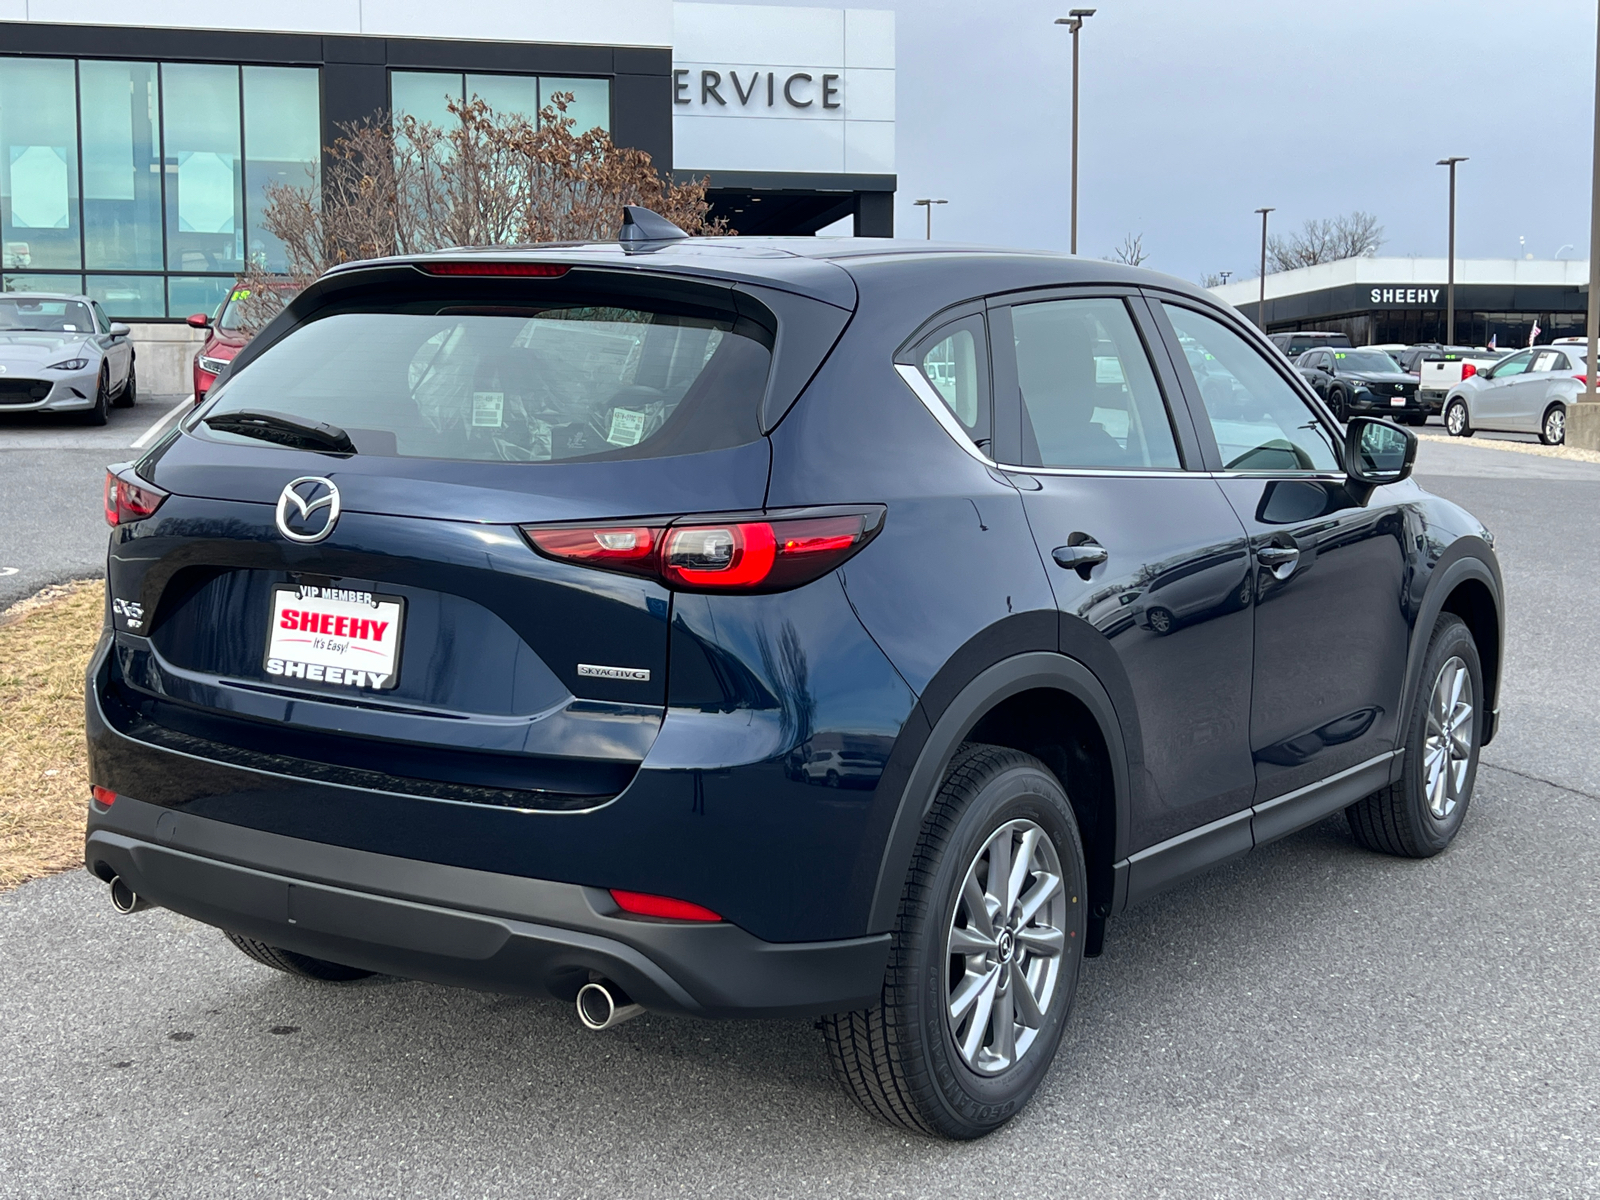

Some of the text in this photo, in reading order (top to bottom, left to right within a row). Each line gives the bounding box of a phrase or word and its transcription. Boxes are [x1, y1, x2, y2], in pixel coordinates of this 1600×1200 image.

[673, 69, 841, 108] ERVICE
[1370, 288, 1440, 303] SHEEHY
[299, 585, 373, 604] VIP MEMBER
[280, 608, 389, 642] SHEEHY
[313, 637, 349, 655] It's Easy!
[266, 658, 389, 689] SHEEHY
